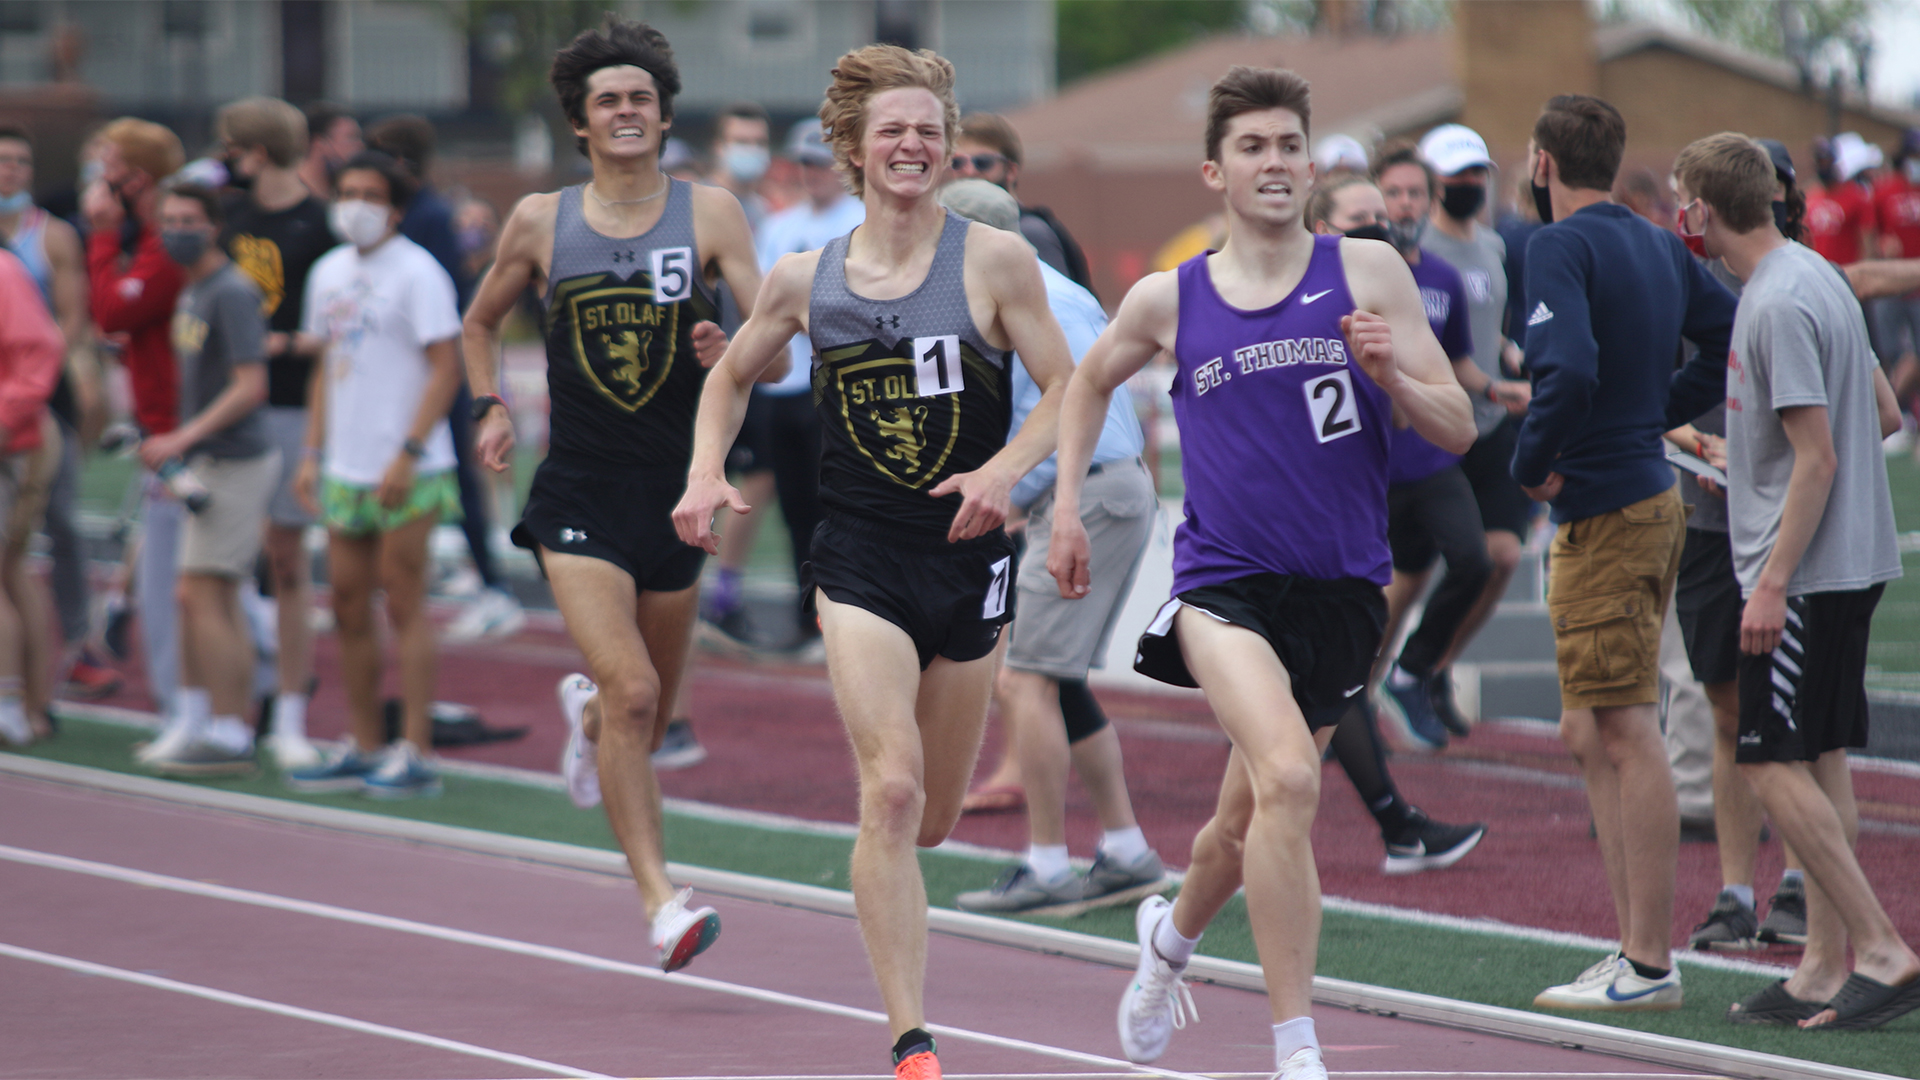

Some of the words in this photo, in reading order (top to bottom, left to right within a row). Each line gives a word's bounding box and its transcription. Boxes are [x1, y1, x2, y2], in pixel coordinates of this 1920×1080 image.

[661, 251, 689, 298] 5
[585, 304, 613, 330] ST.
[616, 302, 667, 326] OLAF
[852, 378, 881, 405] ST.
[885, 374, 936, 400] OL
[922, 339, 950, 390] 1
[1194, 356, 1232, 397] ST.
[1234, 338, 1348, 375] THOMAS
[1313, 377, 1355, 438] 2
[993, 561, 1008, 613] 1
